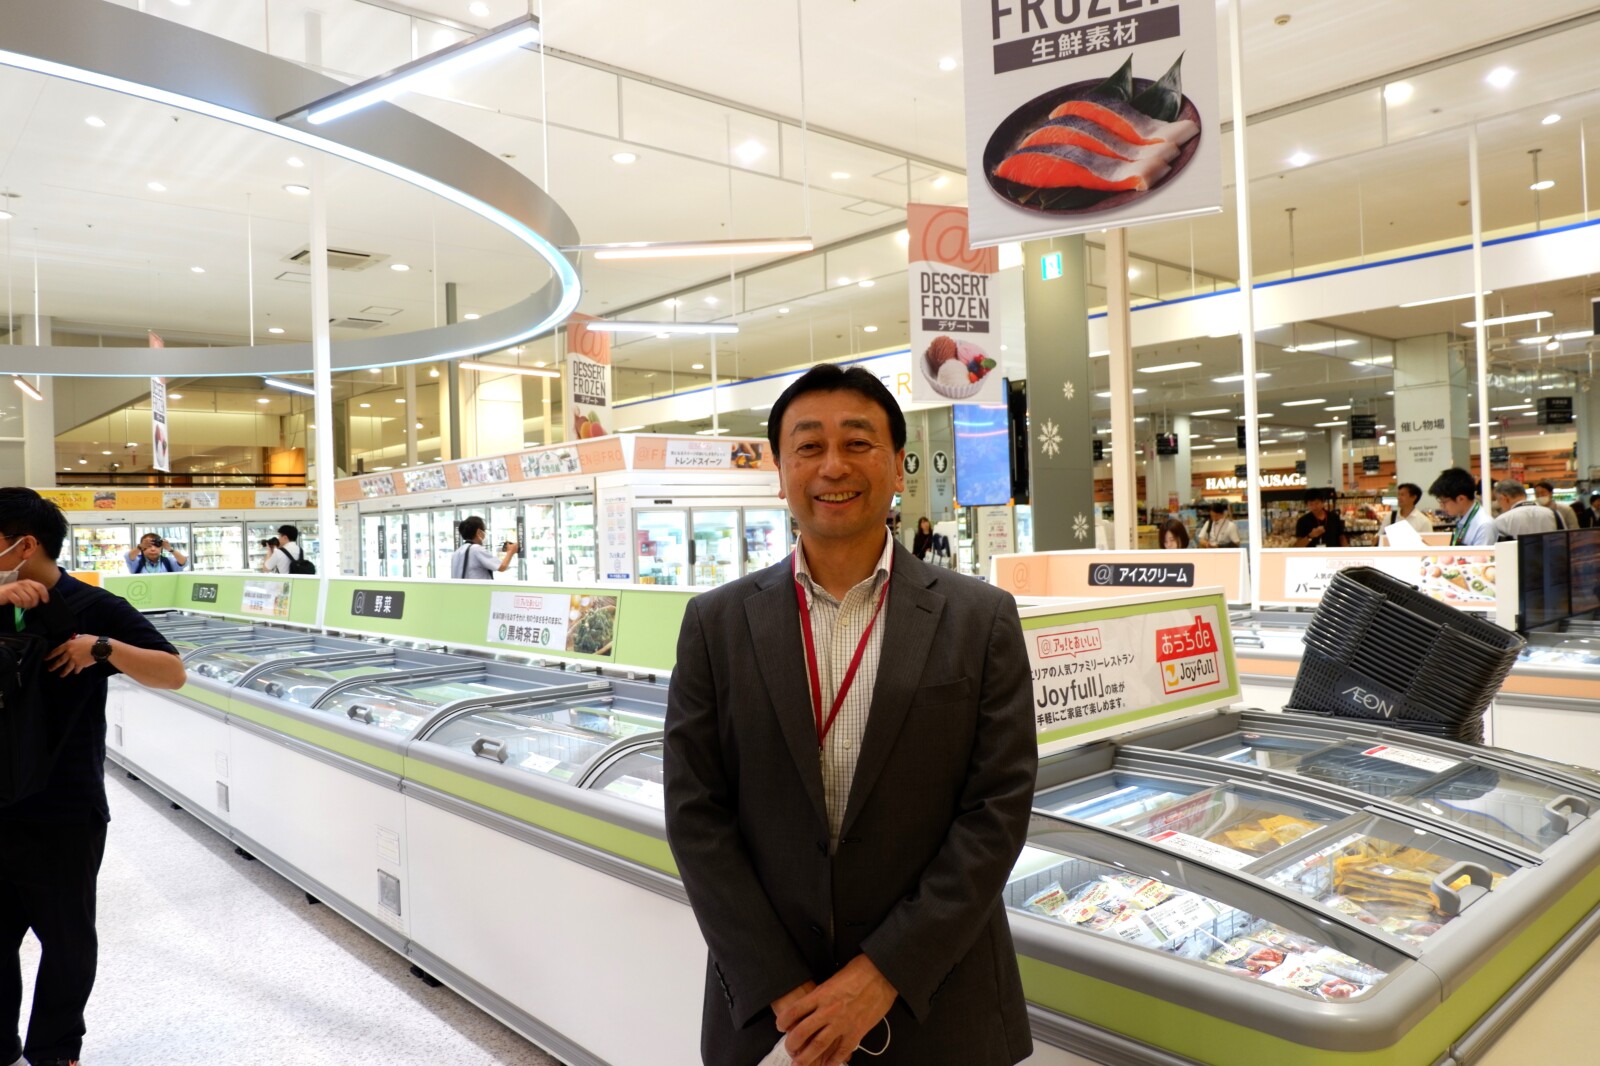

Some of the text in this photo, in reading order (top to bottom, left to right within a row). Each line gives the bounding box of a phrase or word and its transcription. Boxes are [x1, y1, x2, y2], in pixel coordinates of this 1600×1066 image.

[1032, 18, 1139, 63] 生鮮素材
[920, 271, 989, 297] DESSERT
[921, 295, 989, 319] FROZEN
[938, 320, 974, 332] デザート
[573, 360, 605, 381] DESSERT
[573, 377, 606, 396] FROZEN
[1401, 418, 1445, 432] 催し物場
[674, 457, 722, 466] トレンドスイーツ
[1206, 477, 1237, 490] HAM
[1119, 567, 1187, 583] アイスクリーム
[1295, 582, 1328, 593] バー
[374, 595, 392, 613] 野菜
[507, 625, 541, 643] 黒埼茶豆
[1162, 619, 1211, 655] おうちde
[1180, 659, 1215, 682] Joyfull
[1037, 697, 1126, 726] 手軽にご家庭で楽しめます。
